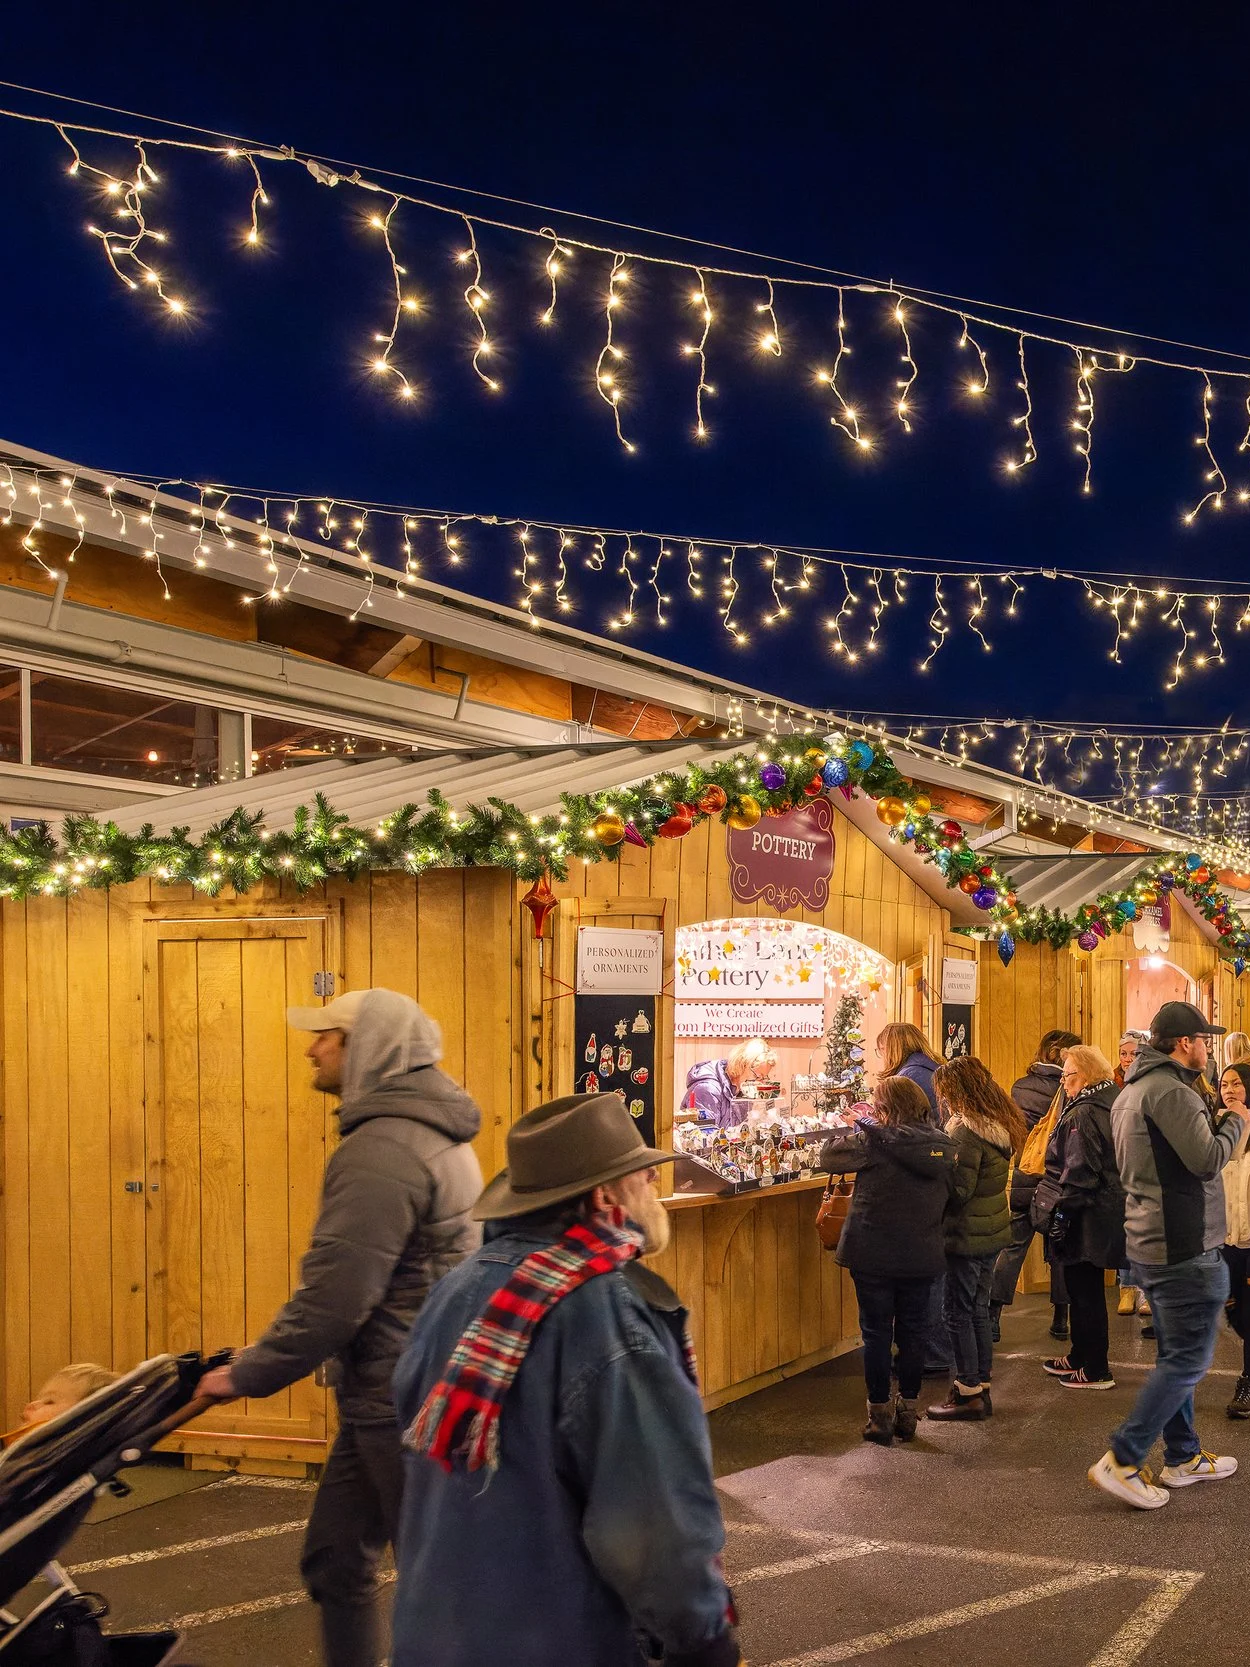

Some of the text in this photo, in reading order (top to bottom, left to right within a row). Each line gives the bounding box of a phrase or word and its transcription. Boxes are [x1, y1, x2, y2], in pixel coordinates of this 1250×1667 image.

[752, 831, 816, 860] POTTERY
[586, 947, 654, 958] PERSONALIZED
[593, 963, 648, 973] ORNAMENTS
[705, 1008, 764, 1018] We Create
[703, 1021, 786, 1032] Personalized
[790, 1021, 819, 1033] Gifts
